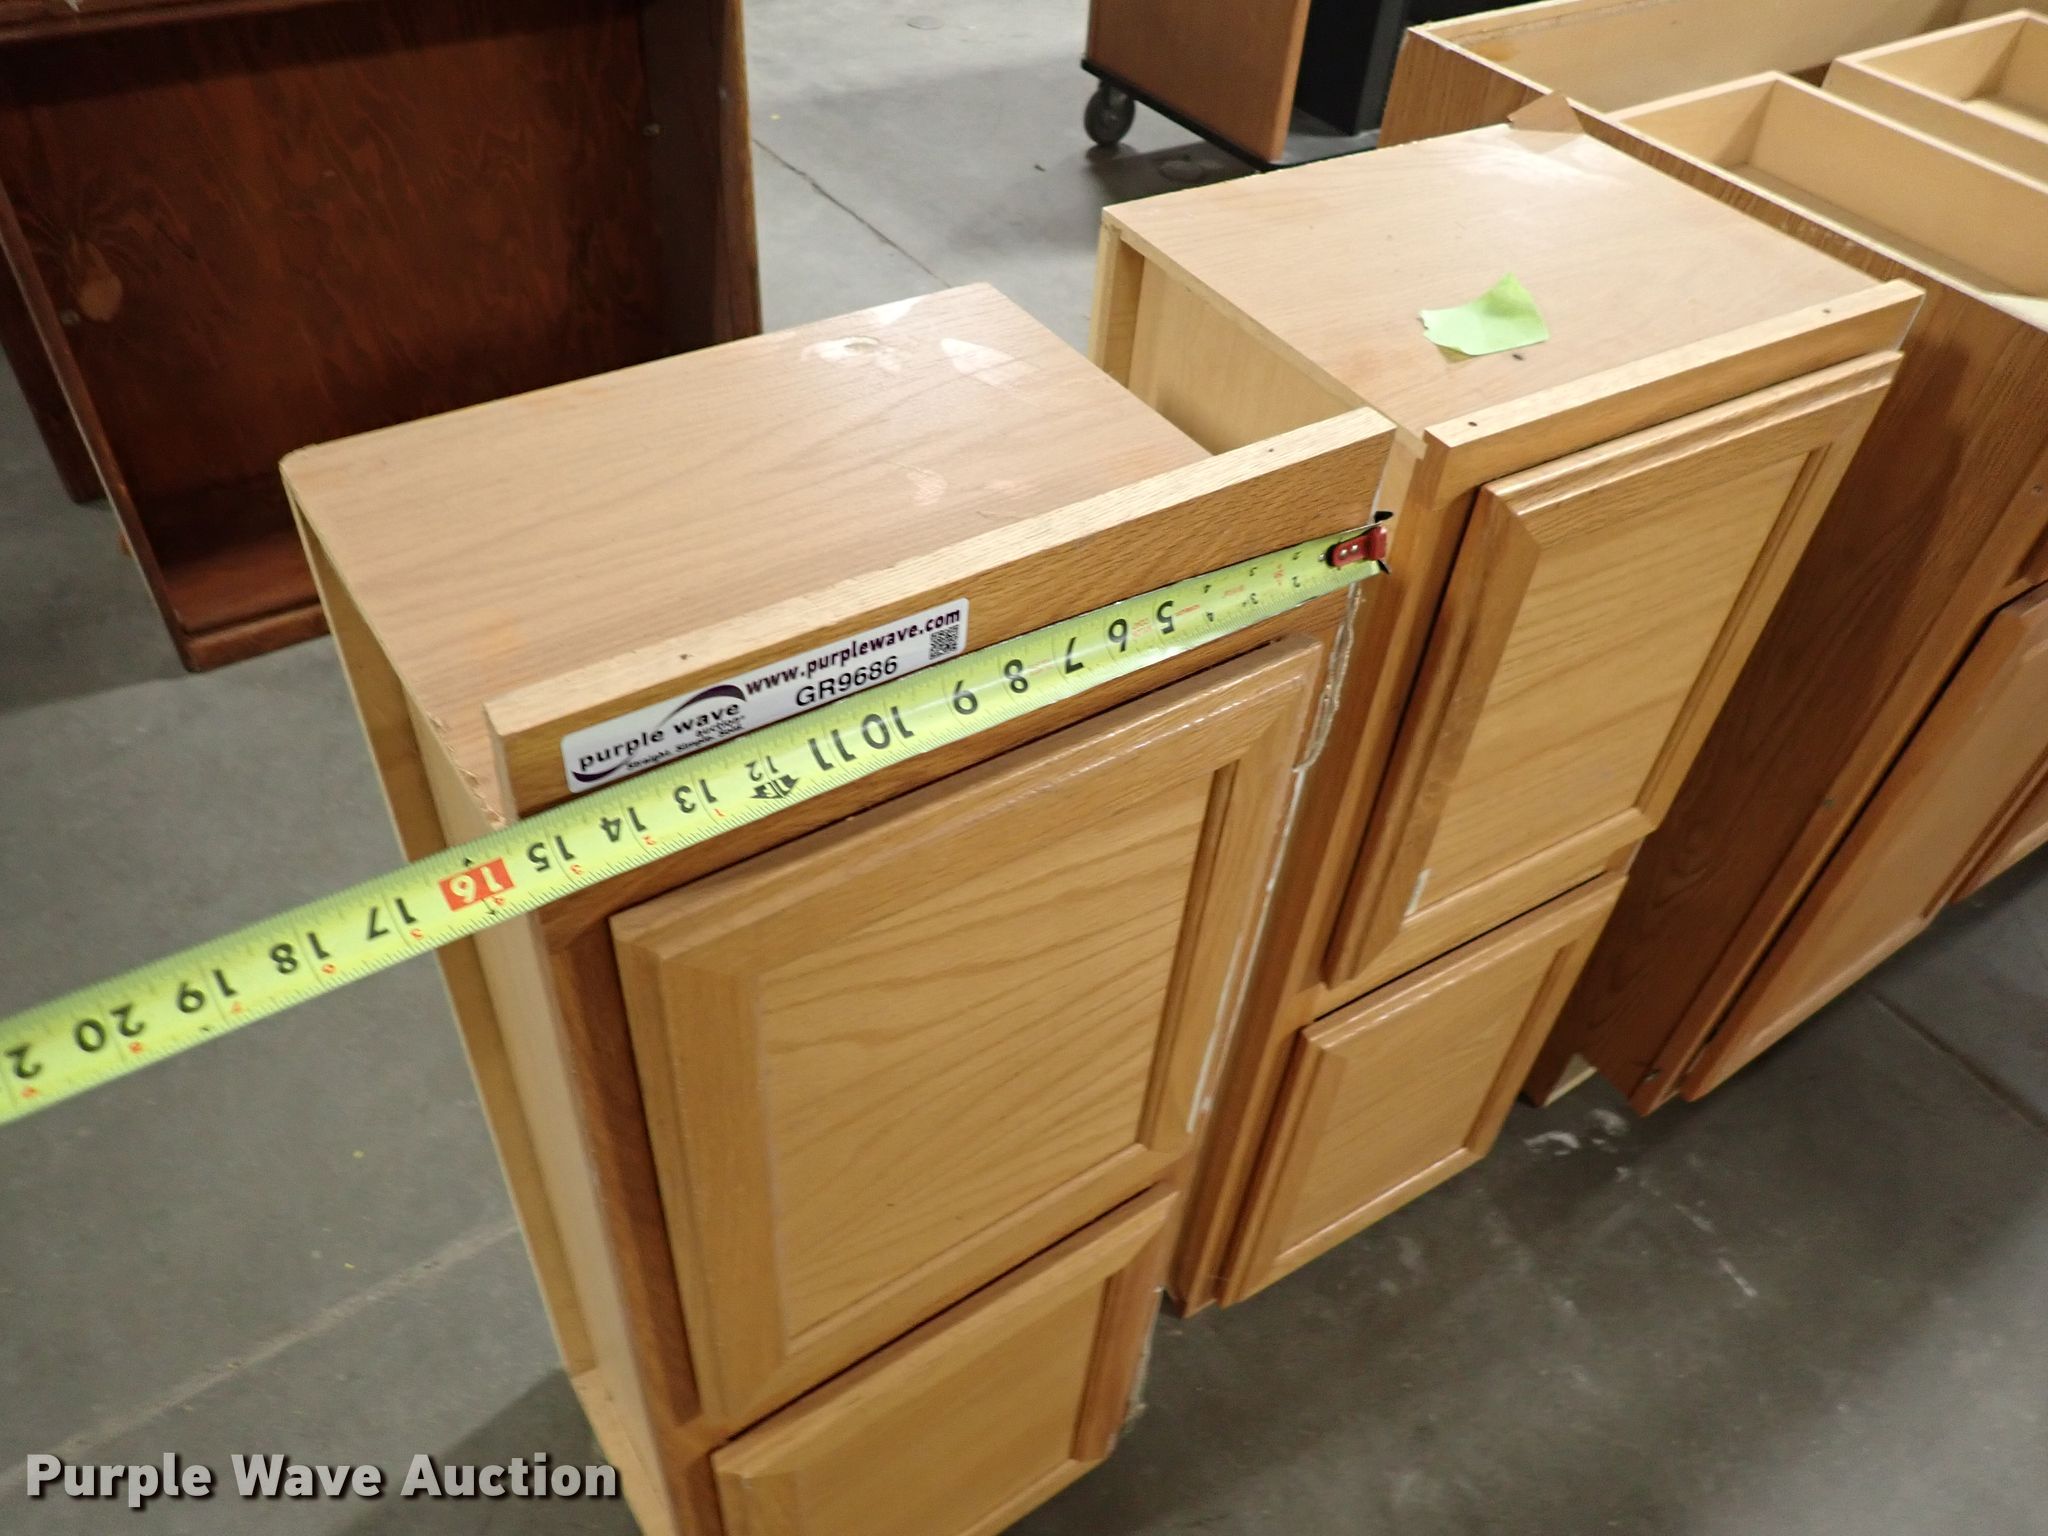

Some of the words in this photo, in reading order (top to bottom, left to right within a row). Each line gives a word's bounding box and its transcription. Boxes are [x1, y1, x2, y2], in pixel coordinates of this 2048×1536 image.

[1107, 618, 1128, 652] 6
[1156, 600, 1175, 634] 5
[745, 609, 961, 696] www.purplewave.com
[1063, 637, 1085, 675] 7
[795, 655, 899, 707] GR9686
[1003, 658, 1030, 693] 8
[952, 680, 979, 715] 9
[578, 729, 664, 771] purple
[673, 703, 739, 734] wave
[861, 705, 915, 750] 10
[745, 755, 779, 781] 12
[808, 729, 857, 772] 11
[673, 779, 718, 814] 13
[600, 807, 649, 843] 14
[526, 835, 576, 873] 15
[450, 865, 504, 904] 16
[364, 897, 417, 940] 17
[268, 931, 331, 975] 18
[176, 968, 238, 1014] 19
[74, 1003, 146, 1053] 20
